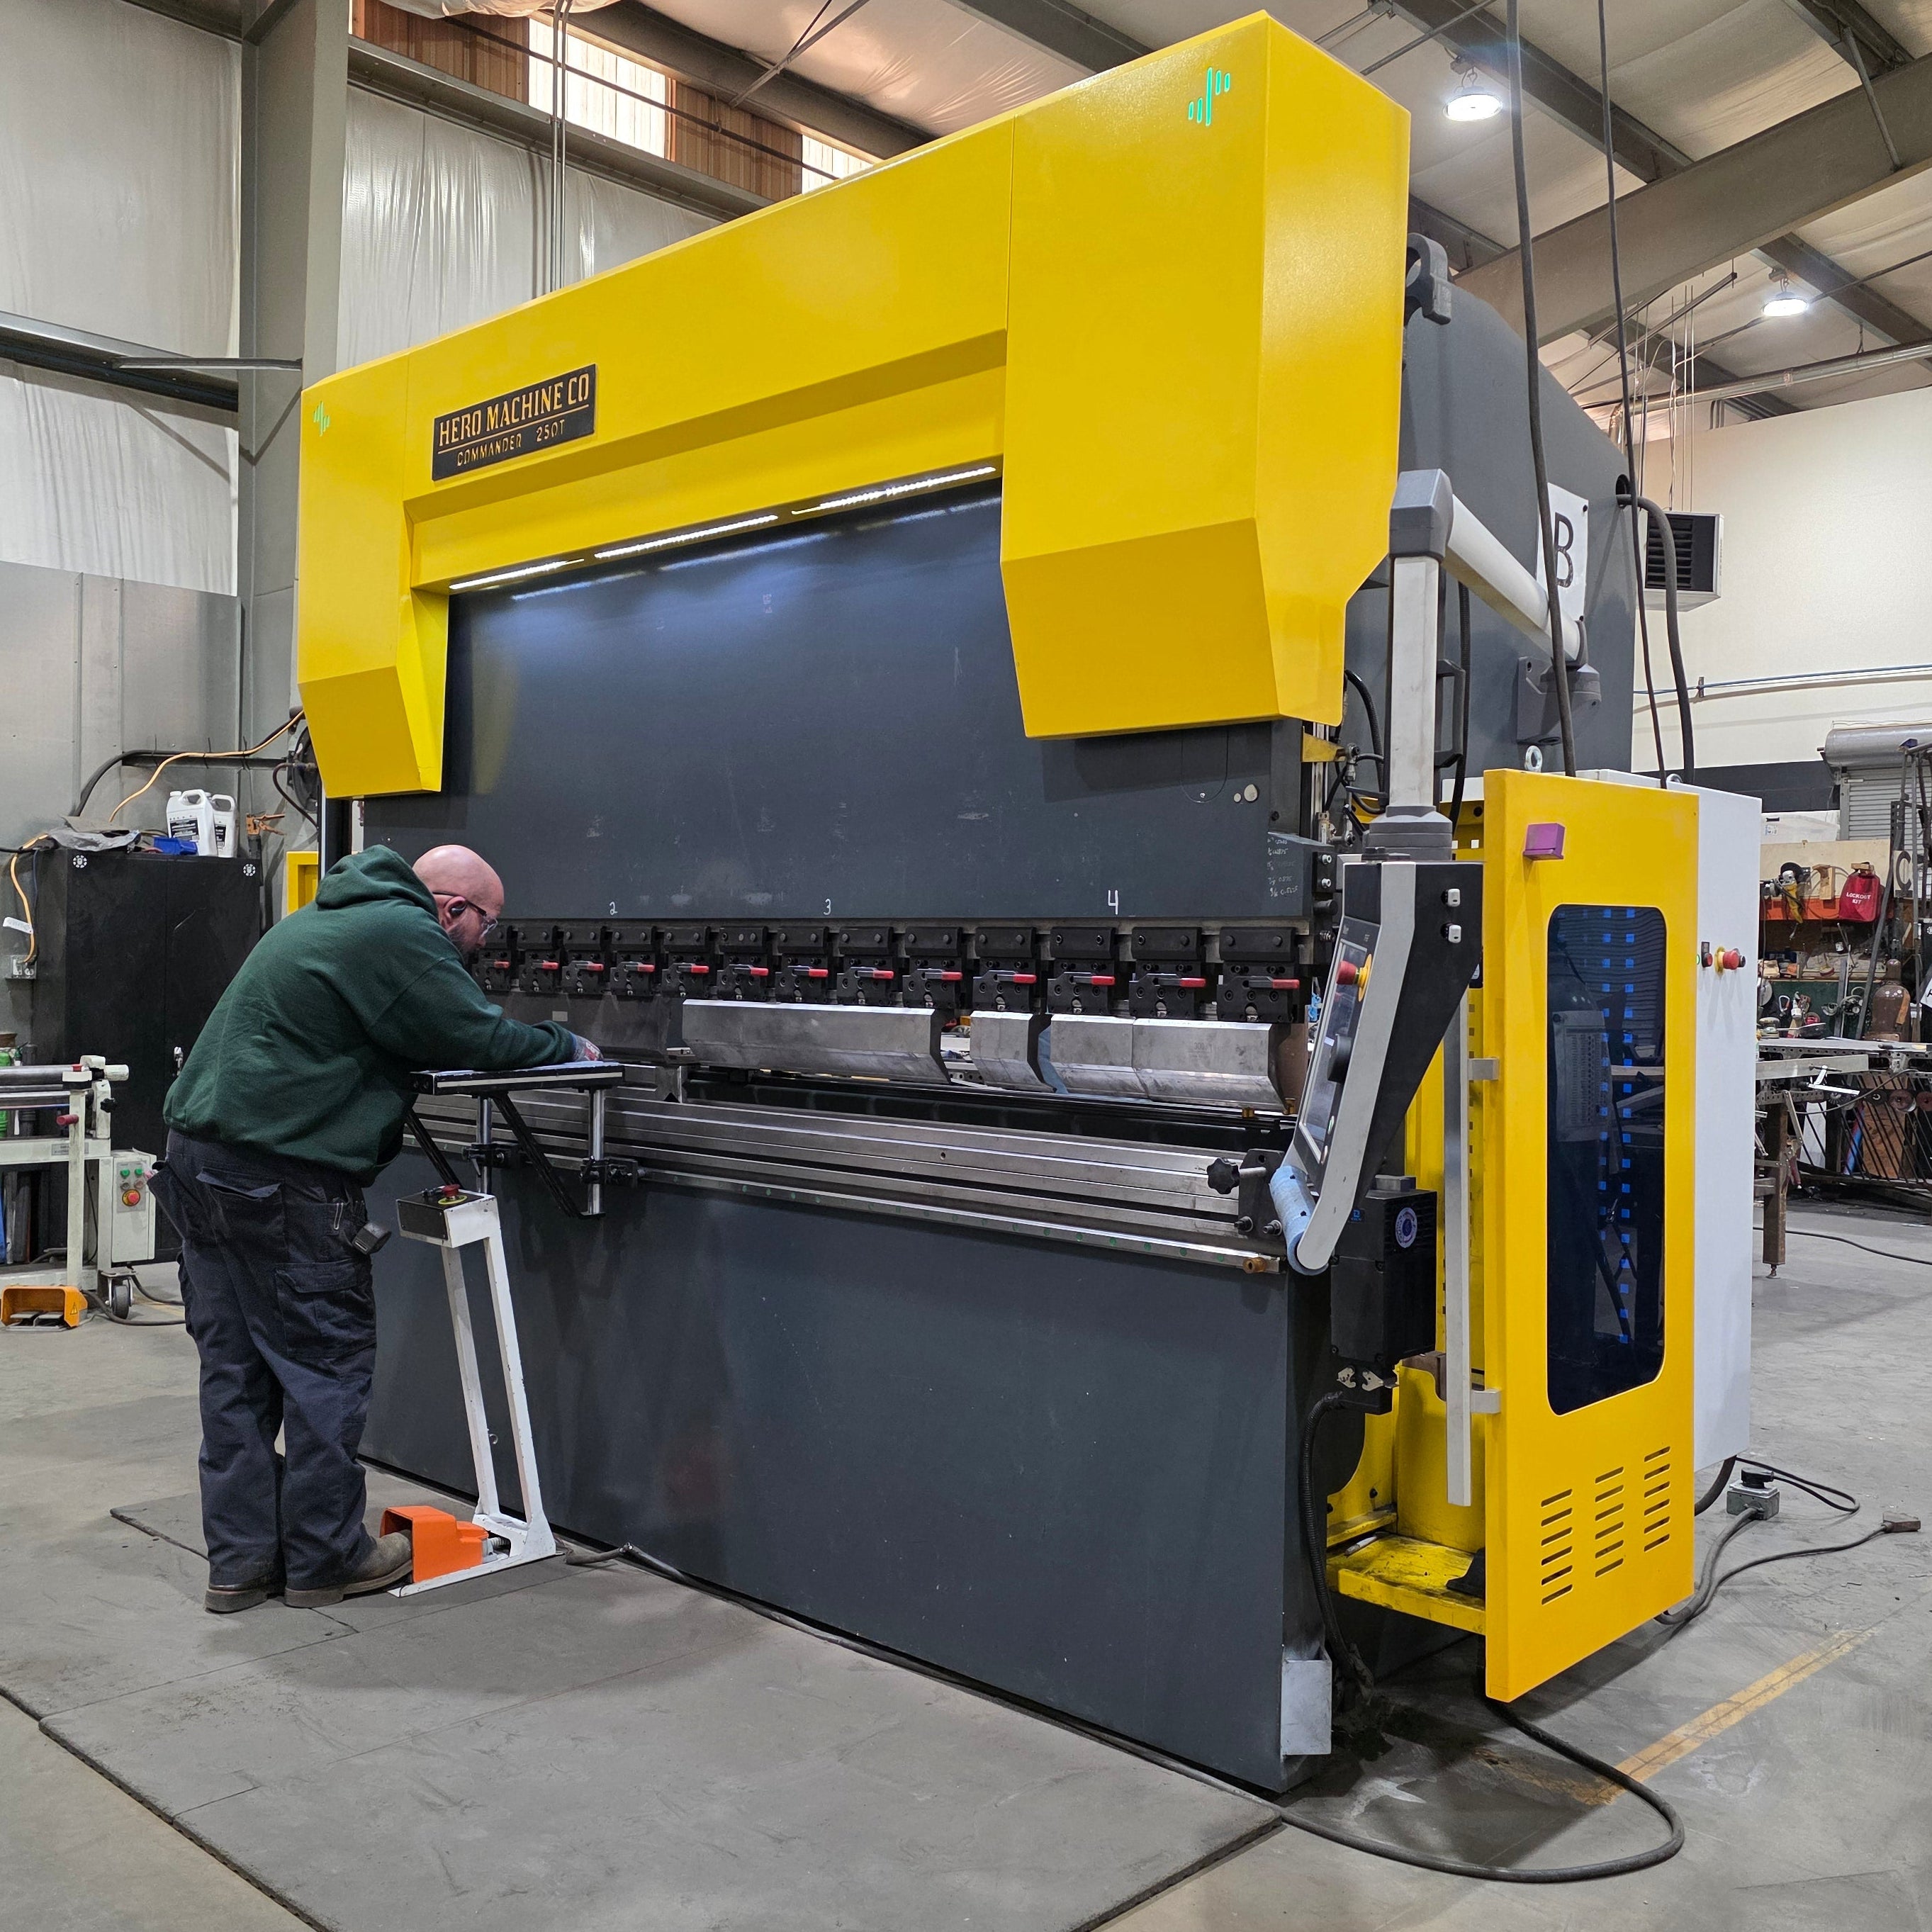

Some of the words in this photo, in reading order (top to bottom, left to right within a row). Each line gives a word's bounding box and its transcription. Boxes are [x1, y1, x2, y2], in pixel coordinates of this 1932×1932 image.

[439, 410, 481, 447] HERO
[486, 381, 563, 432] MACHINE
[568, 373, 590, 405] CO
[456, 433, 522, 466] COMMANDER
[536, 419, 565, 442] 250T
[1554, 512, 1573, 588] B
[610, 901, 618, 915] 2
[823, 898, 831, 915] 3
[1108, 889, 1118, 915] 4
